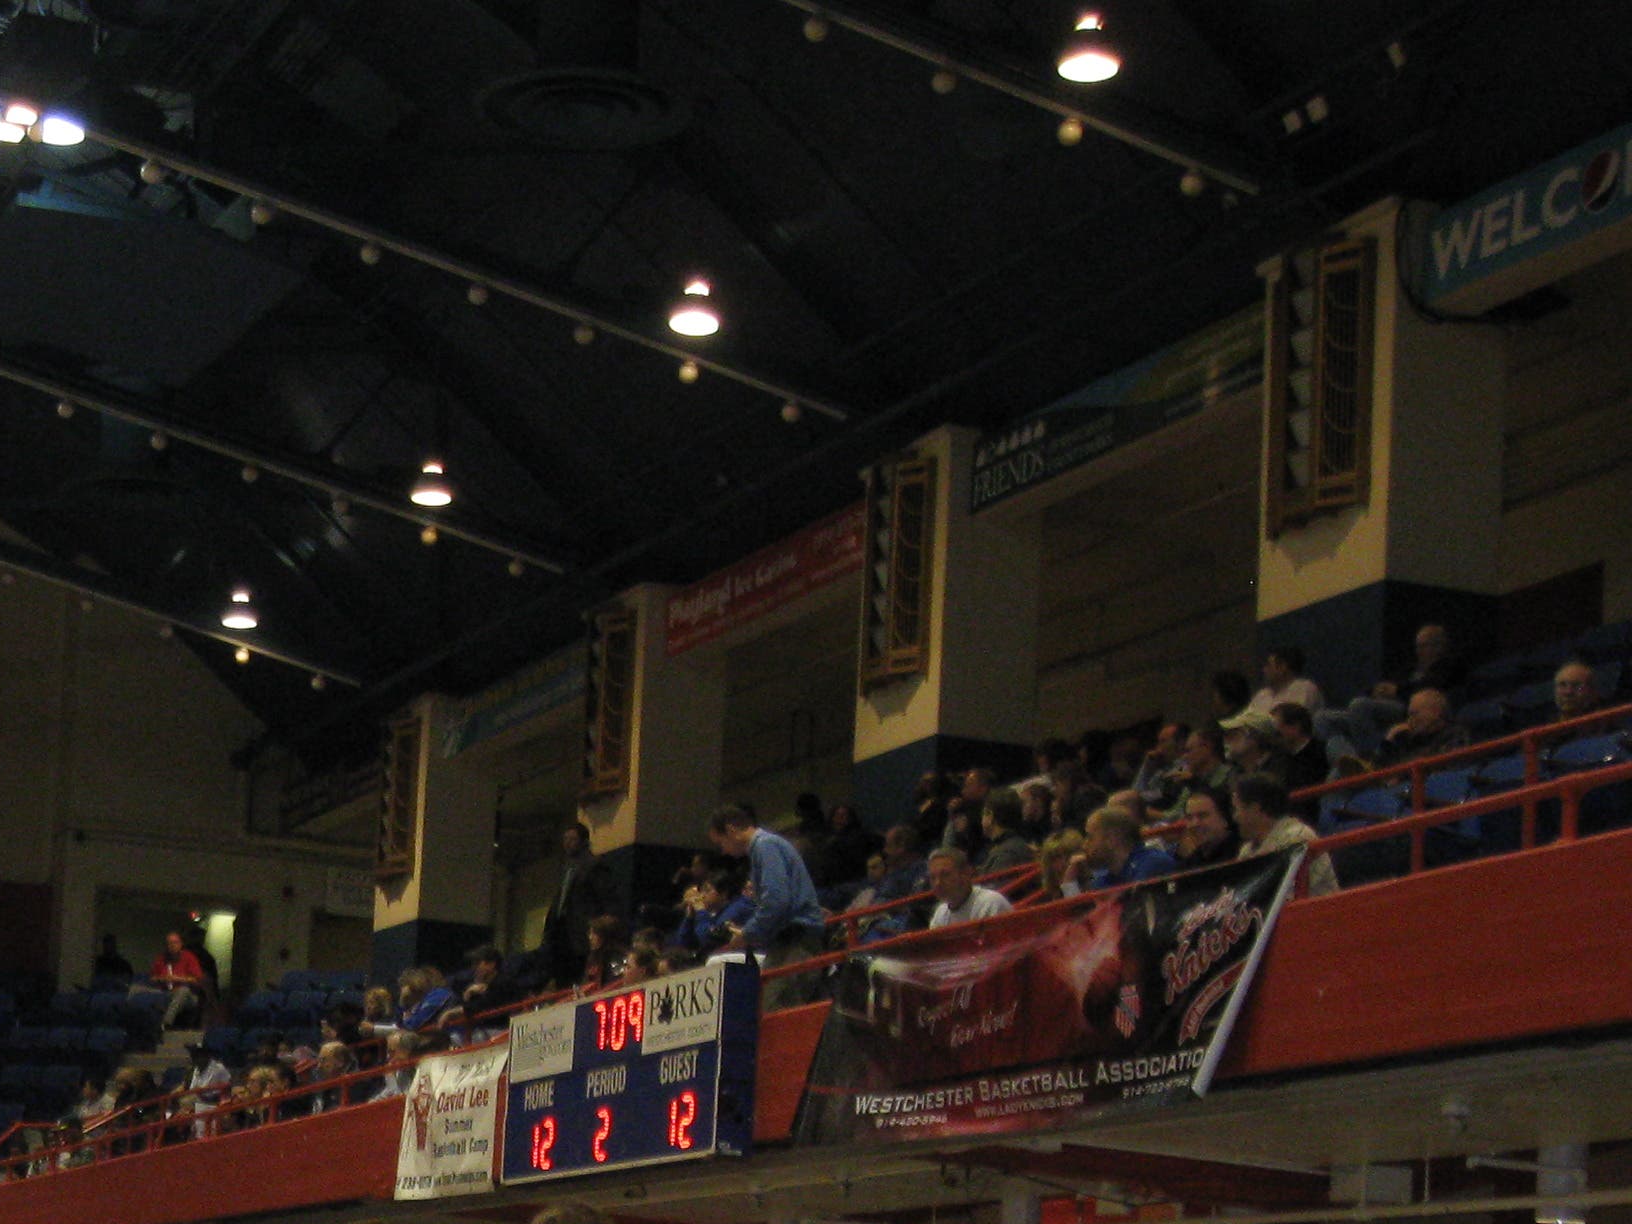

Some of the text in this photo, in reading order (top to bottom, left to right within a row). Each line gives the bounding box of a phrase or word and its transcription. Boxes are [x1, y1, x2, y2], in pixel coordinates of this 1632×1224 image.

[649, 974, 716, 1027] PARKS
[586, 1064, 627, 1100] PERIOD
[658, 1049, 701, 1086] GUEST
[855, 1047, 1206, 1116] WESTCHESTER BASKETBALL ASSOCIATIO
[436, 1085, 490, 1115] David Lee
[524, 1079, 555, 1112] HOME
[666, 1089, 699, 1151] 12
[531, 1115, 559, 1172] 12
[591, 1104, 614, 1164] 2
